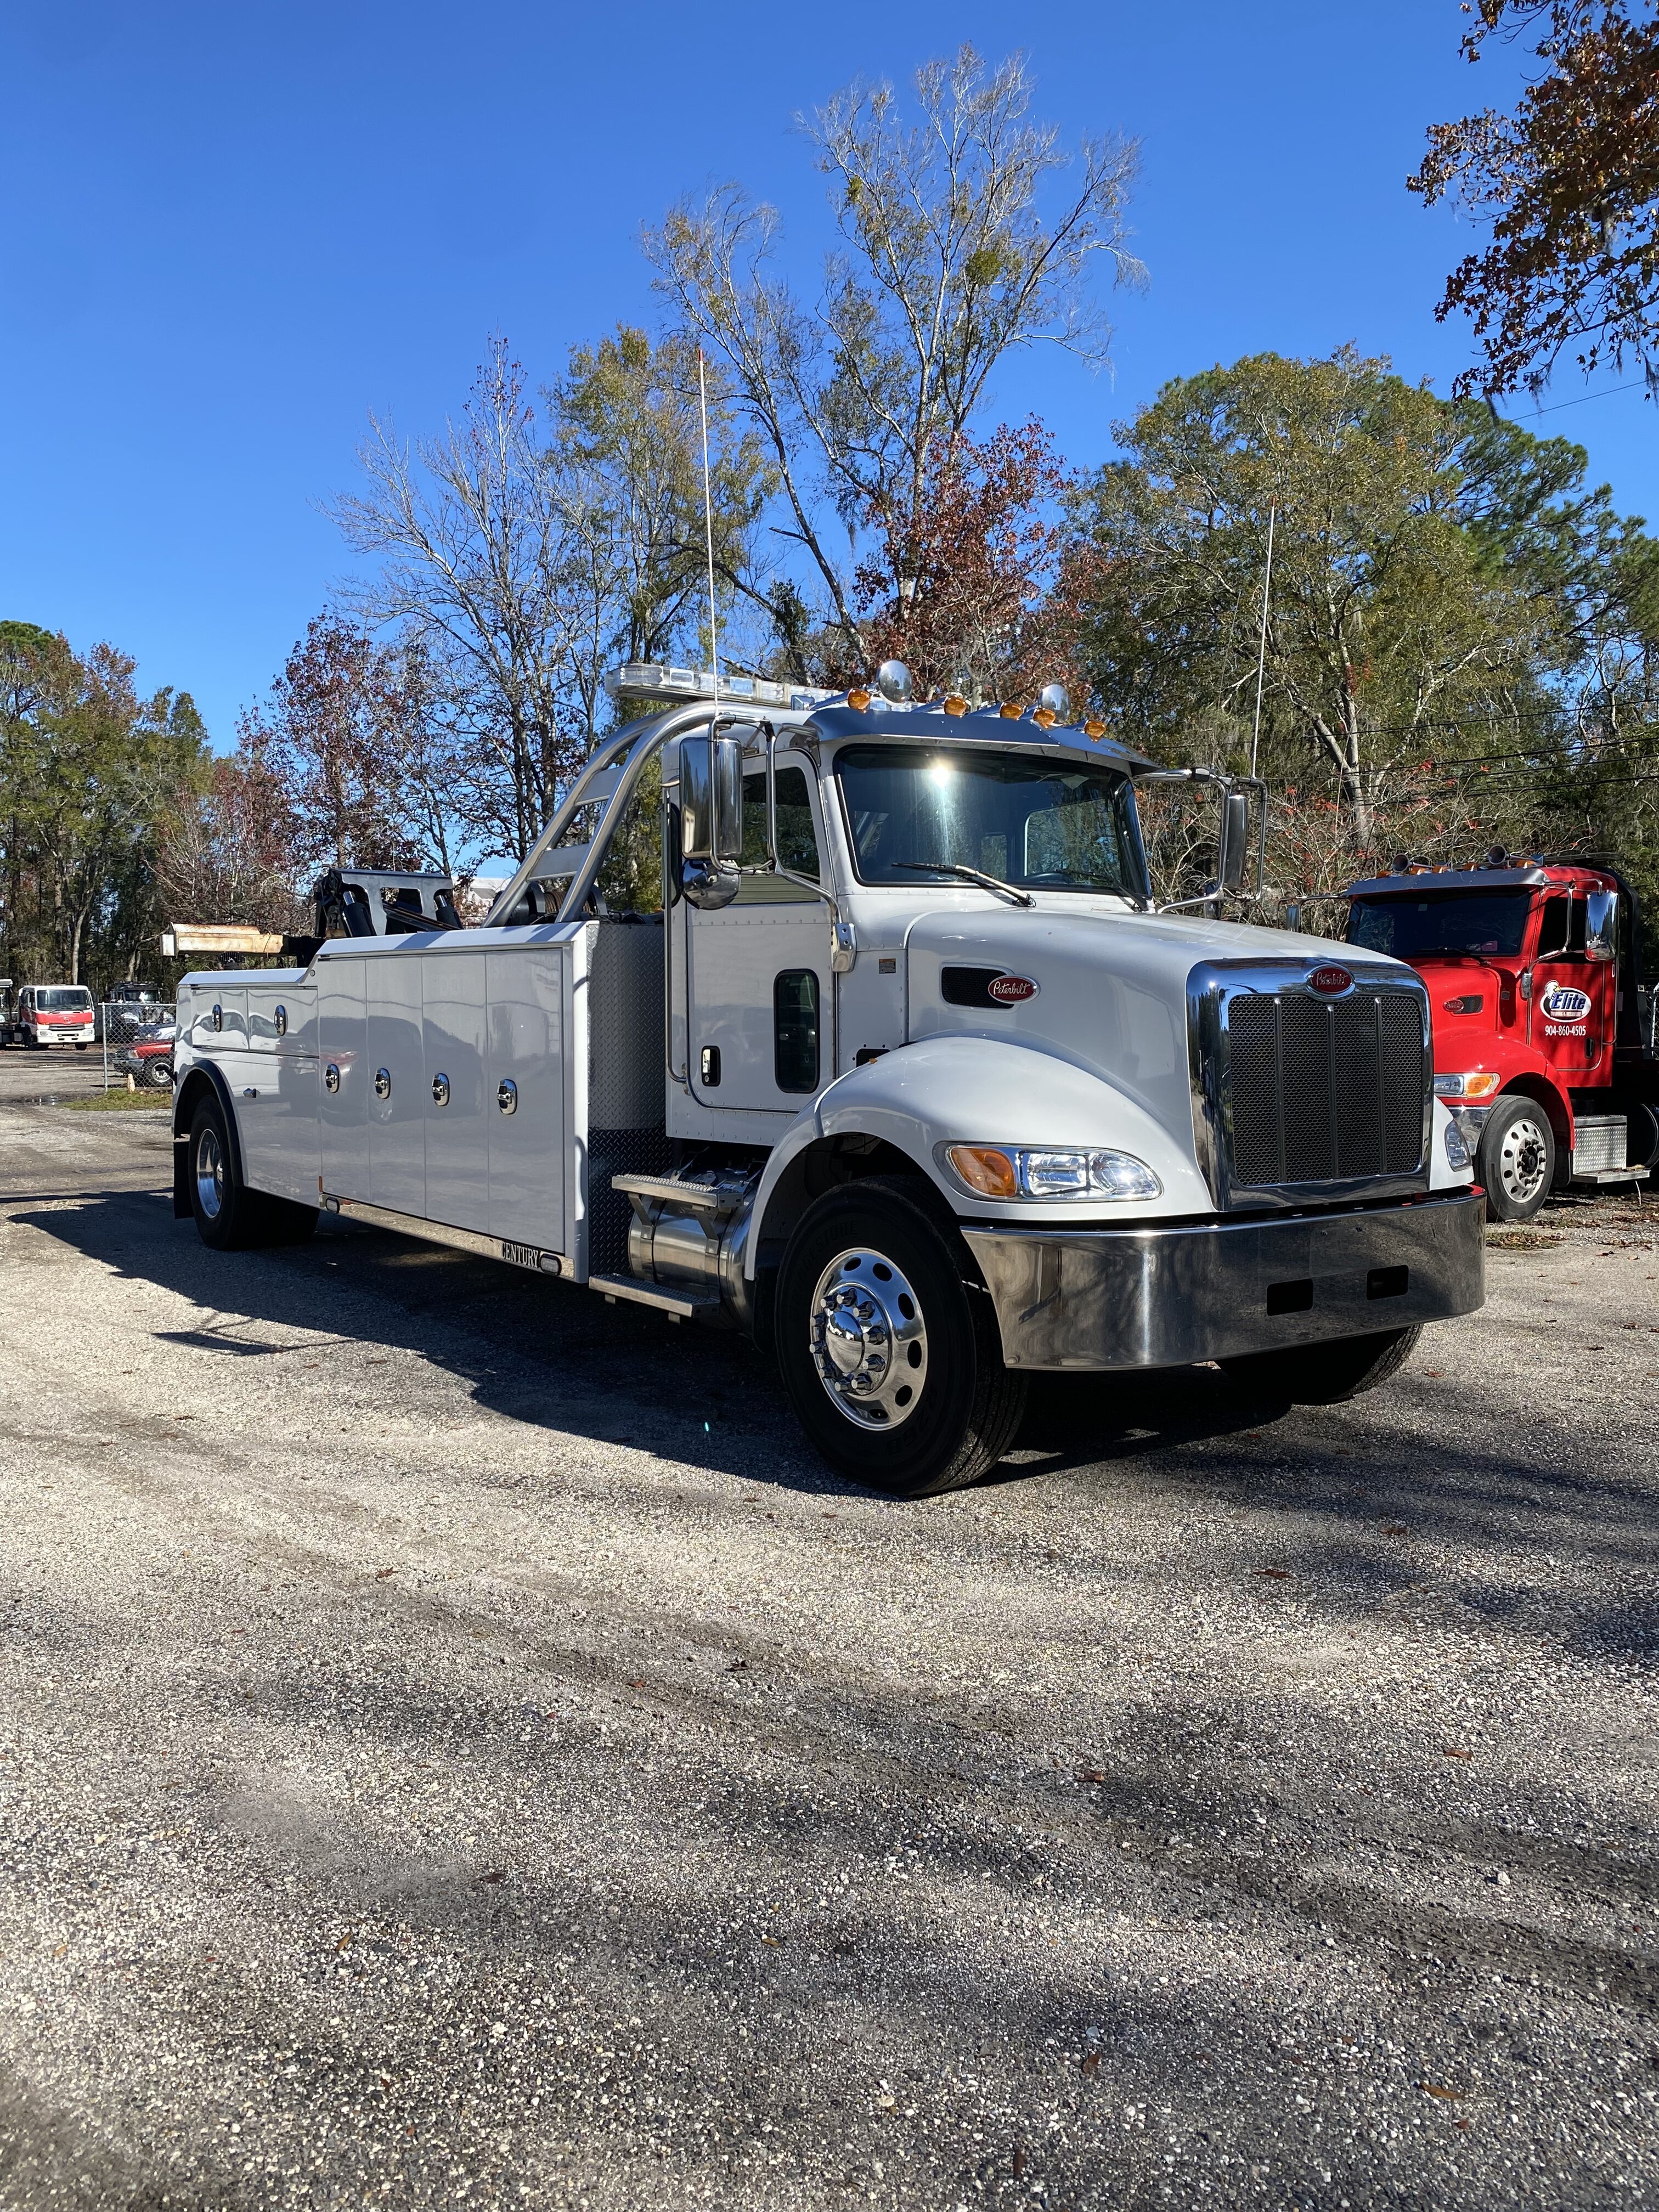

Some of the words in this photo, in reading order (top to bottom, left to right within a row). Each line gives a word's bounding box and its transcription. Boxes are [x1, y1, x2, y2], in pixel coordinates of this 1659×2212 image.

[1317, 972, 1348, 986] Peterbilt
[994, 981, 1030, 995] Peterbilt
[1551, 992, 1586, 1010] Elite
[1545, 1025, 1587, 1036] 904-860-4505
[502, 1242, 539, 1268] CENTURY
